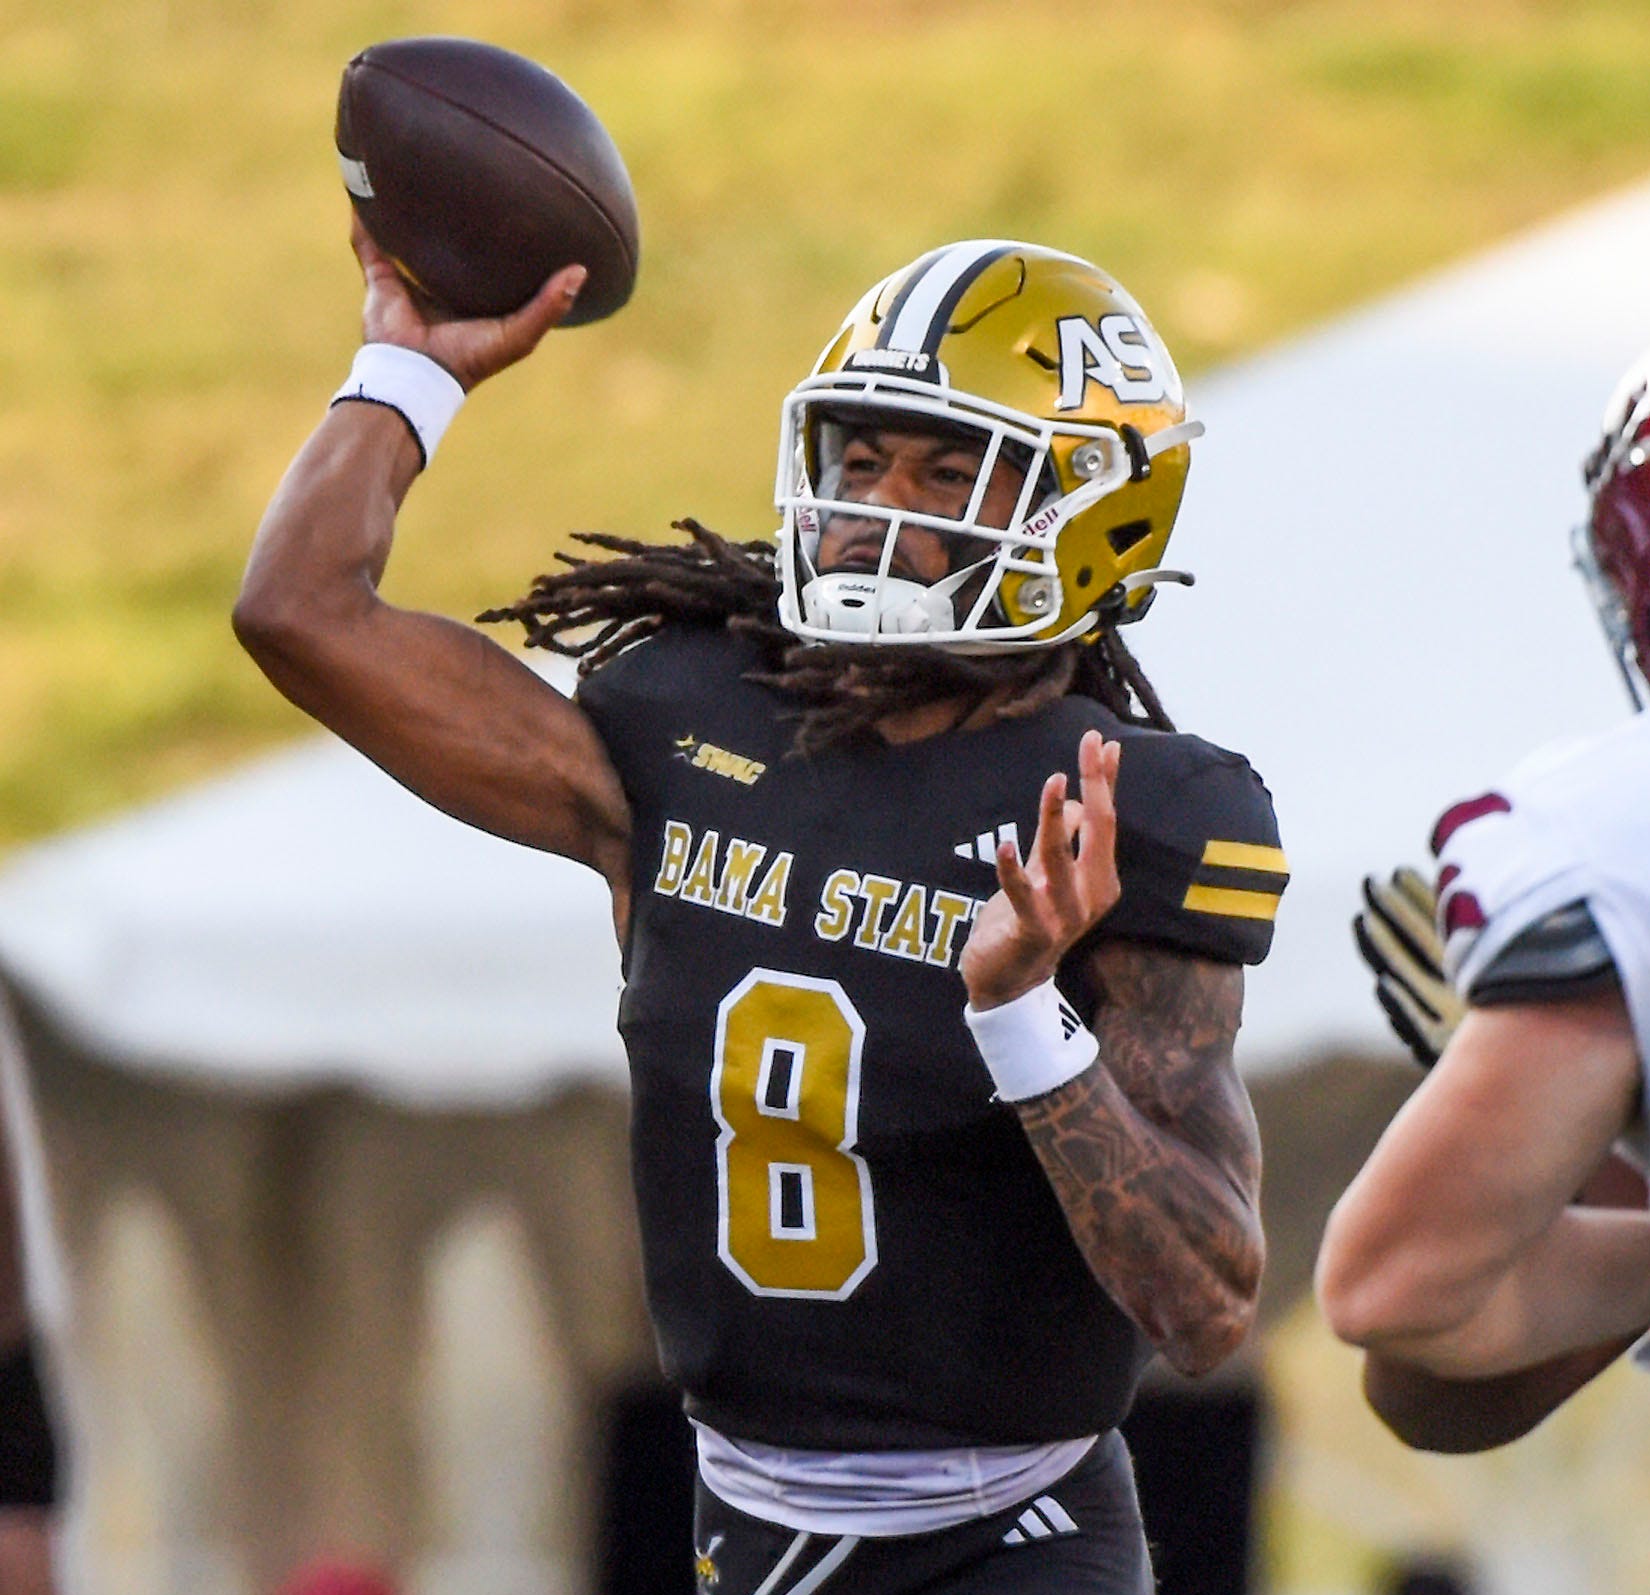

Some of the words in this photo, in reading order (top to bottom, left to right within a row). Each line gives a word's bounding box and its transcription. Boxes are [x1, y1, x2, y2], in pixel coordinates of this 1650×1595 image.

[691, 742, 767, 786] SWAC
[653, 819, 795, 928] BAMA
[711, 966, 879, 1301] 8
